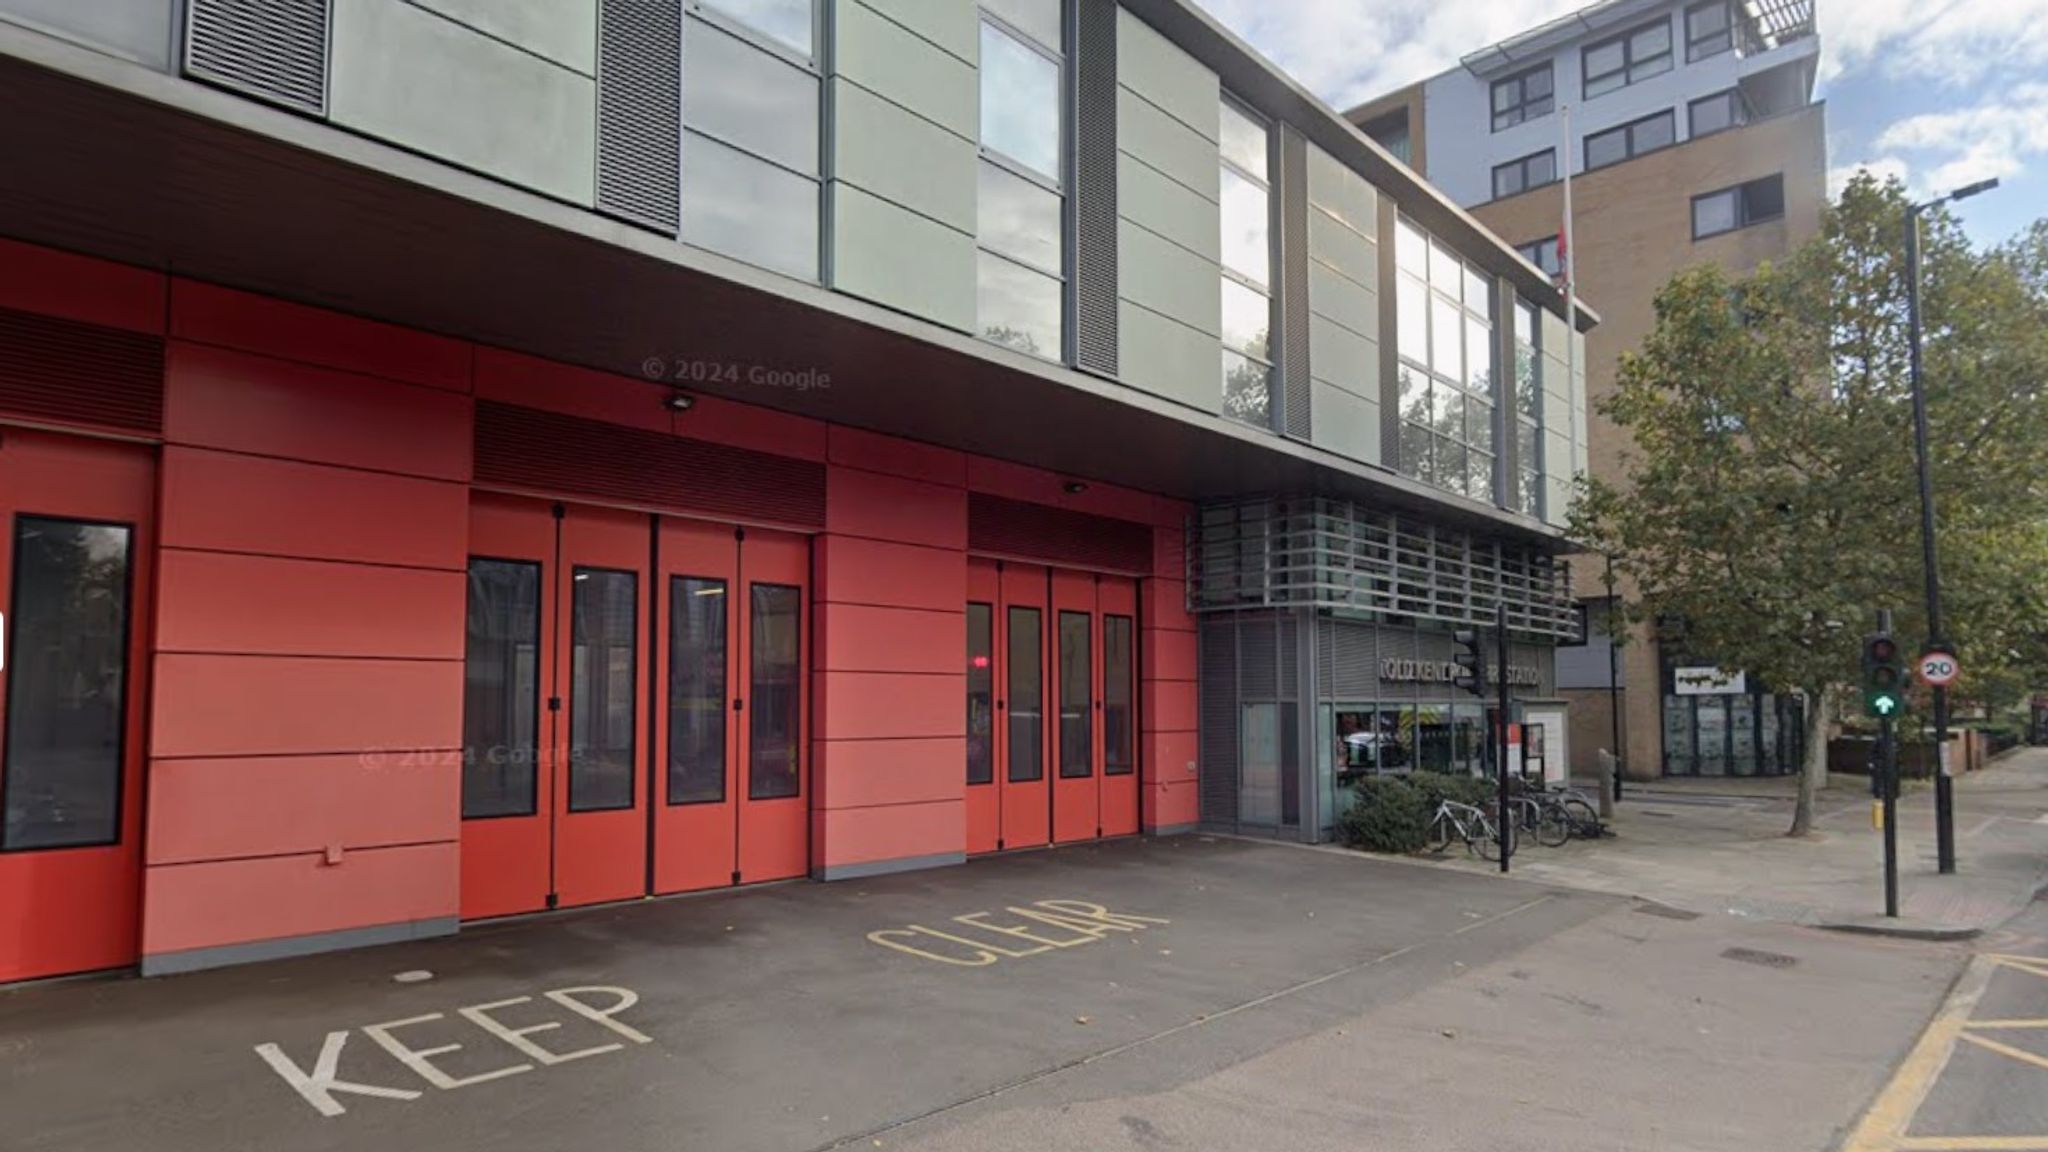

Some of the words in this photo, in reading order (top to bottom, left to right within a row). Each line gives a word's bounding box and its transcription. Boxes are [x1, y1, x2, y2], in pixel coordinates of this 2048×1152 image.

[1924, 662, 1952, 676] 20
[253, 985, 654, 1117] KEEP
[867, 899, 1171, 967] CLEAR
